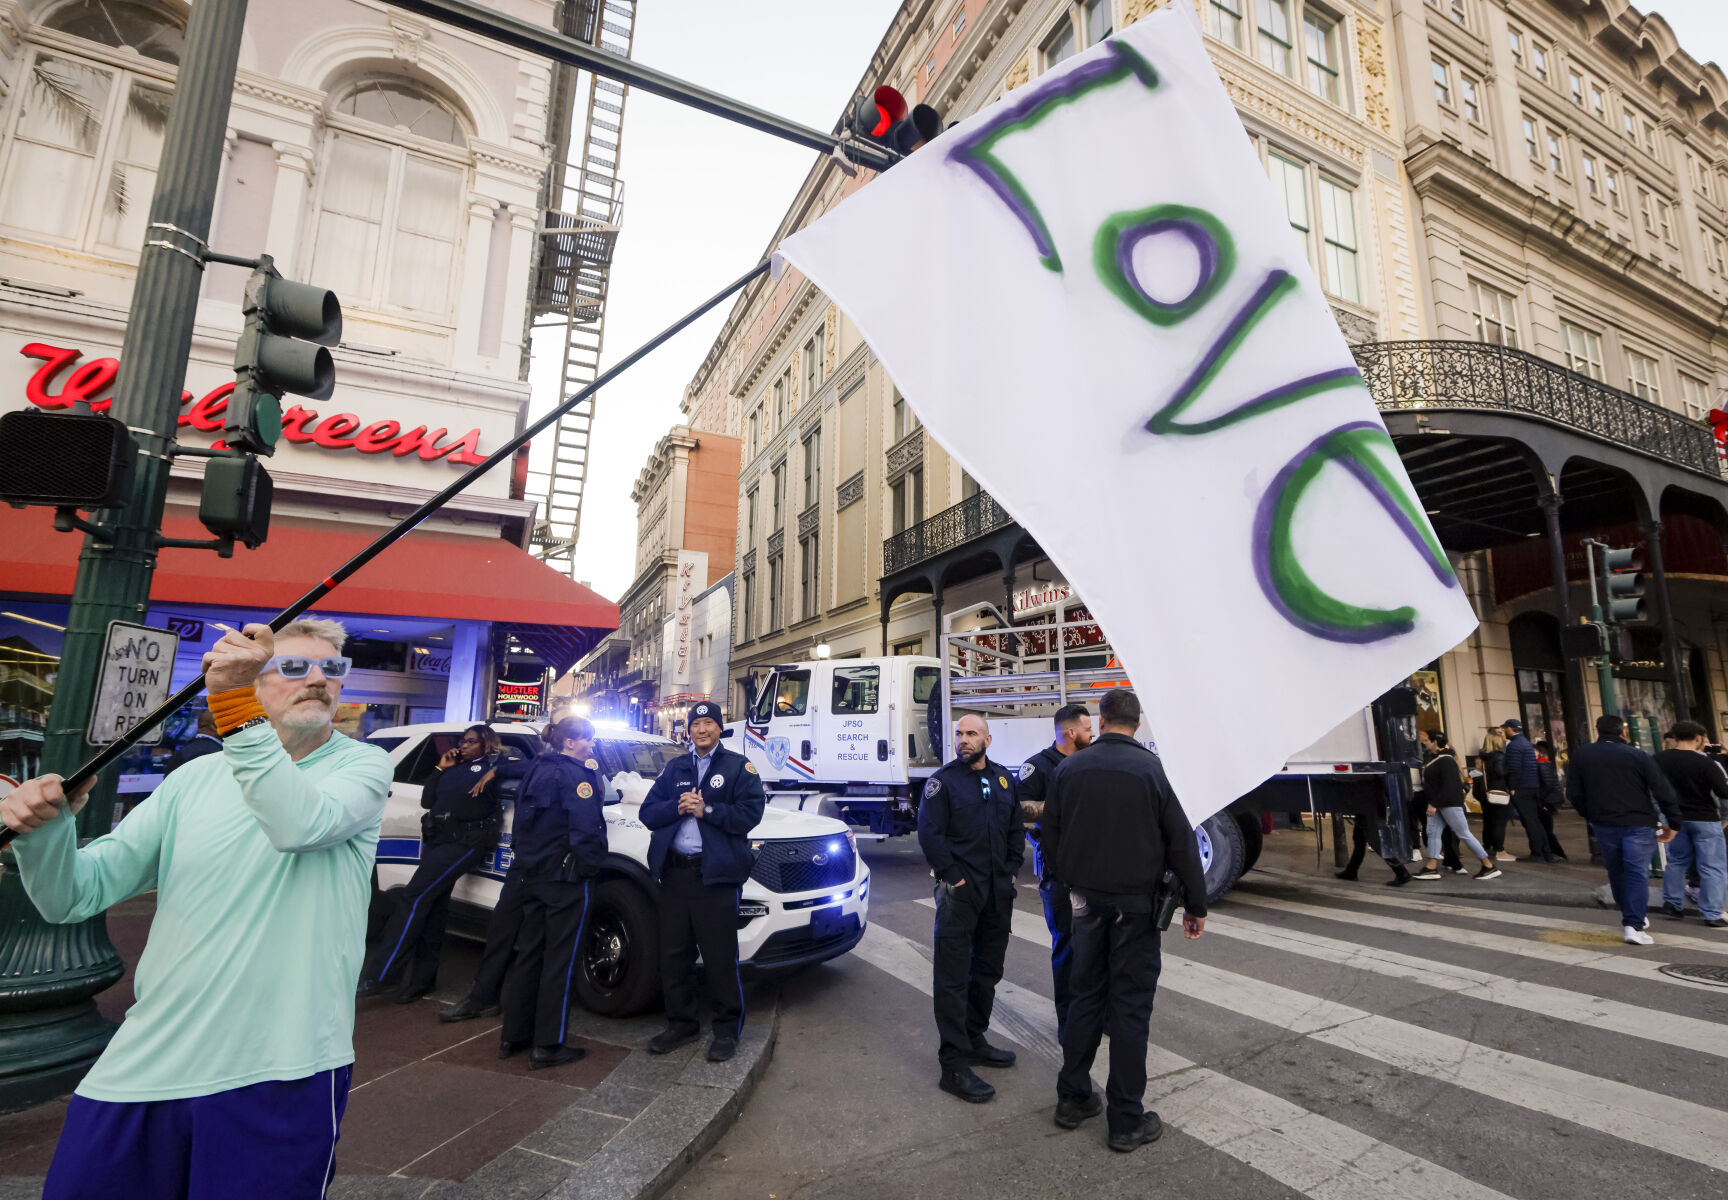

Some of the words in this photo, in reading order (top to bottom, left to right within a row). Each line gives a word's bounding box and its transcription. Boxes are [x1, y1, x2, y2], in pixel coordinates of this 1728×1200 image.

[126, 638, 160, 661] NO
[119, 666, 159, 686] TURN
[498, 685, 538, 694] HUSTLER
[123, 691, 147, 708] ON
[843, 720, 863, 728] JPSO
[837, 733, 869, 742] SEARCH
[850, 743, 856, 751] &
[837, 753, 869, 761] RESCUE
